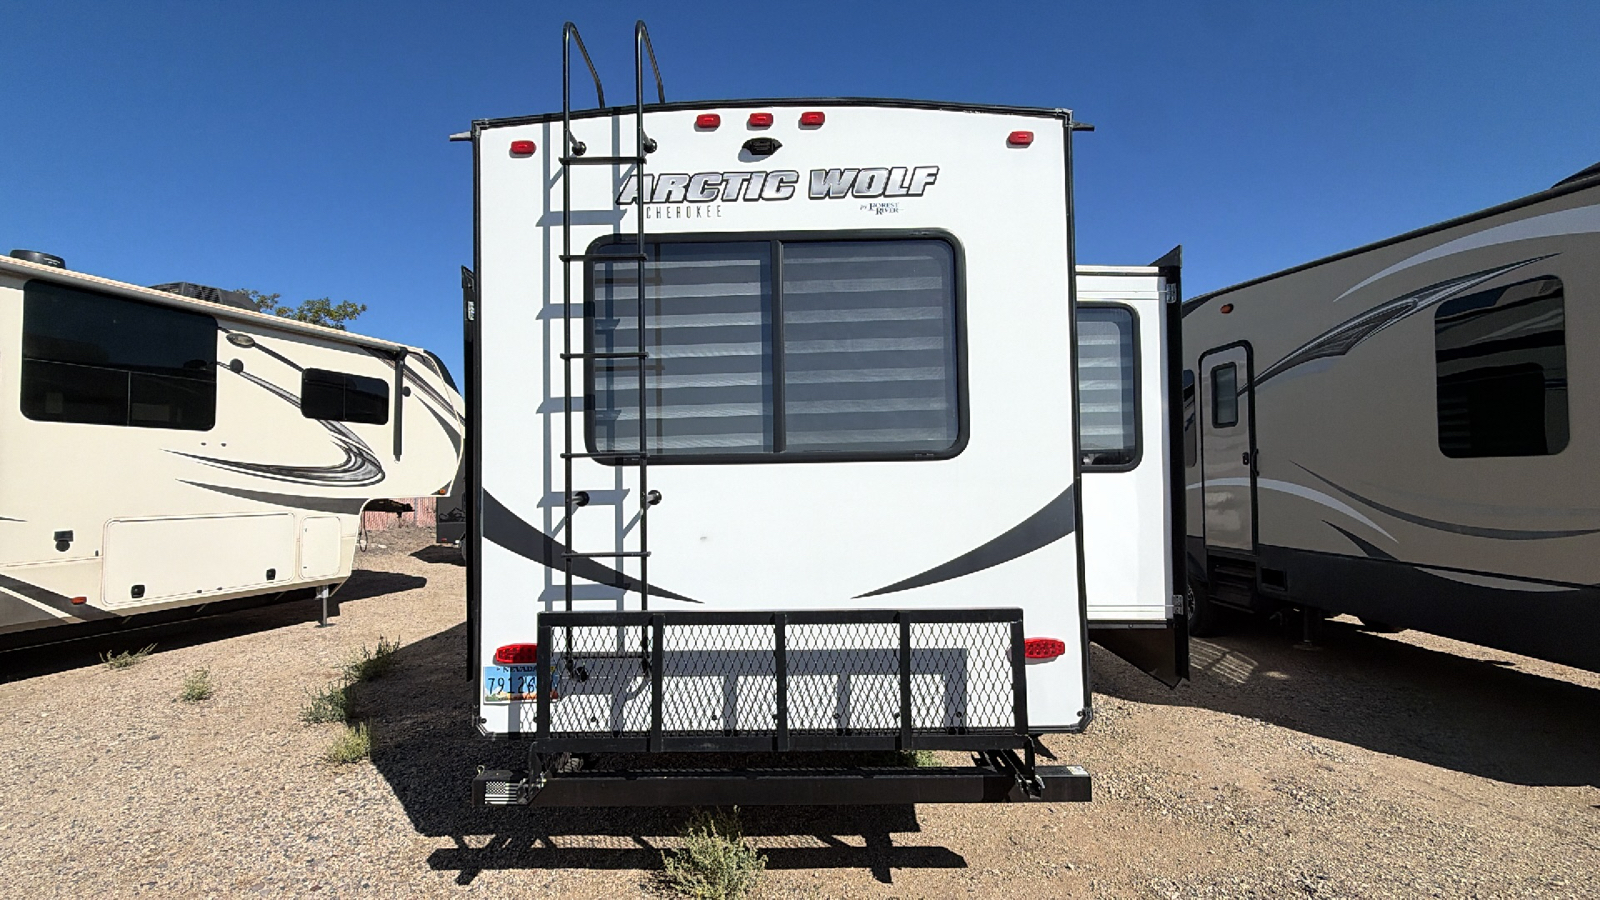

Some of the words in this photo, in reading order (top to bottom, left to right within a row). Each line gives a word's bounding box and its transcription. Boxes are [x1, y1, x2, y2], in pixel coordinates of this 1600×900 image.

[616, 169, 800, 205] ARCTIC
[808, 165, 940, 200] WOLF
[646, 205, 722, 219] CHEROKEE
